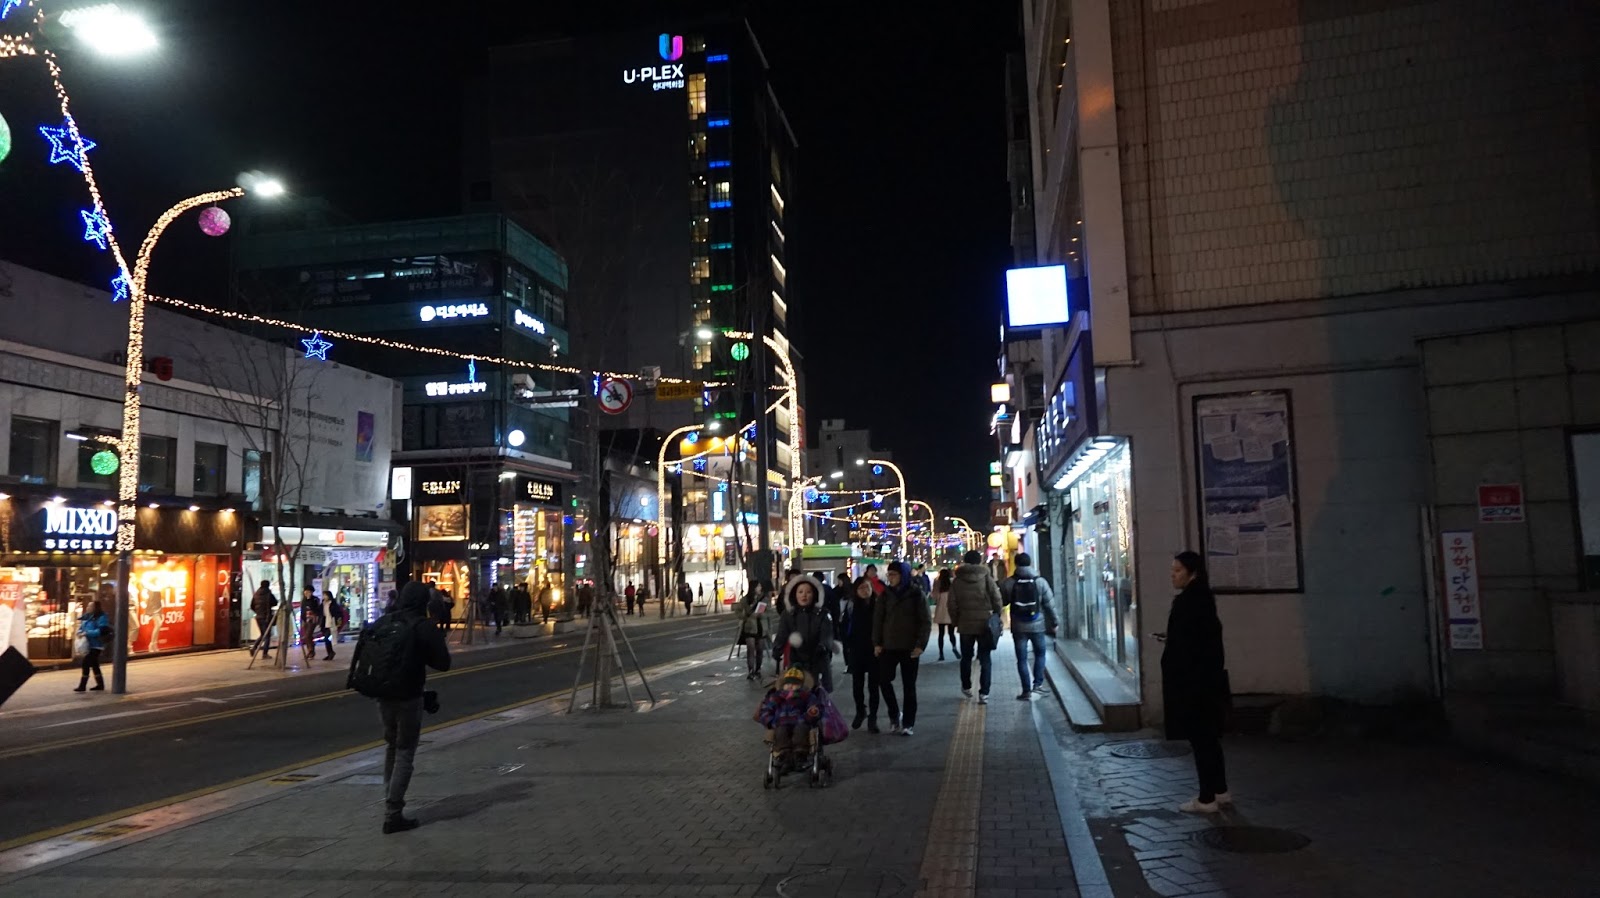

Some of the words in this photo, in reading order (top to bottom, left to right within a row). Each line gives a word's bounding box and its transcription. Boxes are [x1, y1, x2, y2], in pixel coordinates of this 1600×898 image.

[623, 64, 684, 84] U-PLEX
[422, 480, 461, 491] EBLIN
[45, 507, 117, 535] MIXXO
[45, 539, 115, 549] SECRET
[141, 588, 187, 608] SLE
[165, 610, 185, 624] 50%
